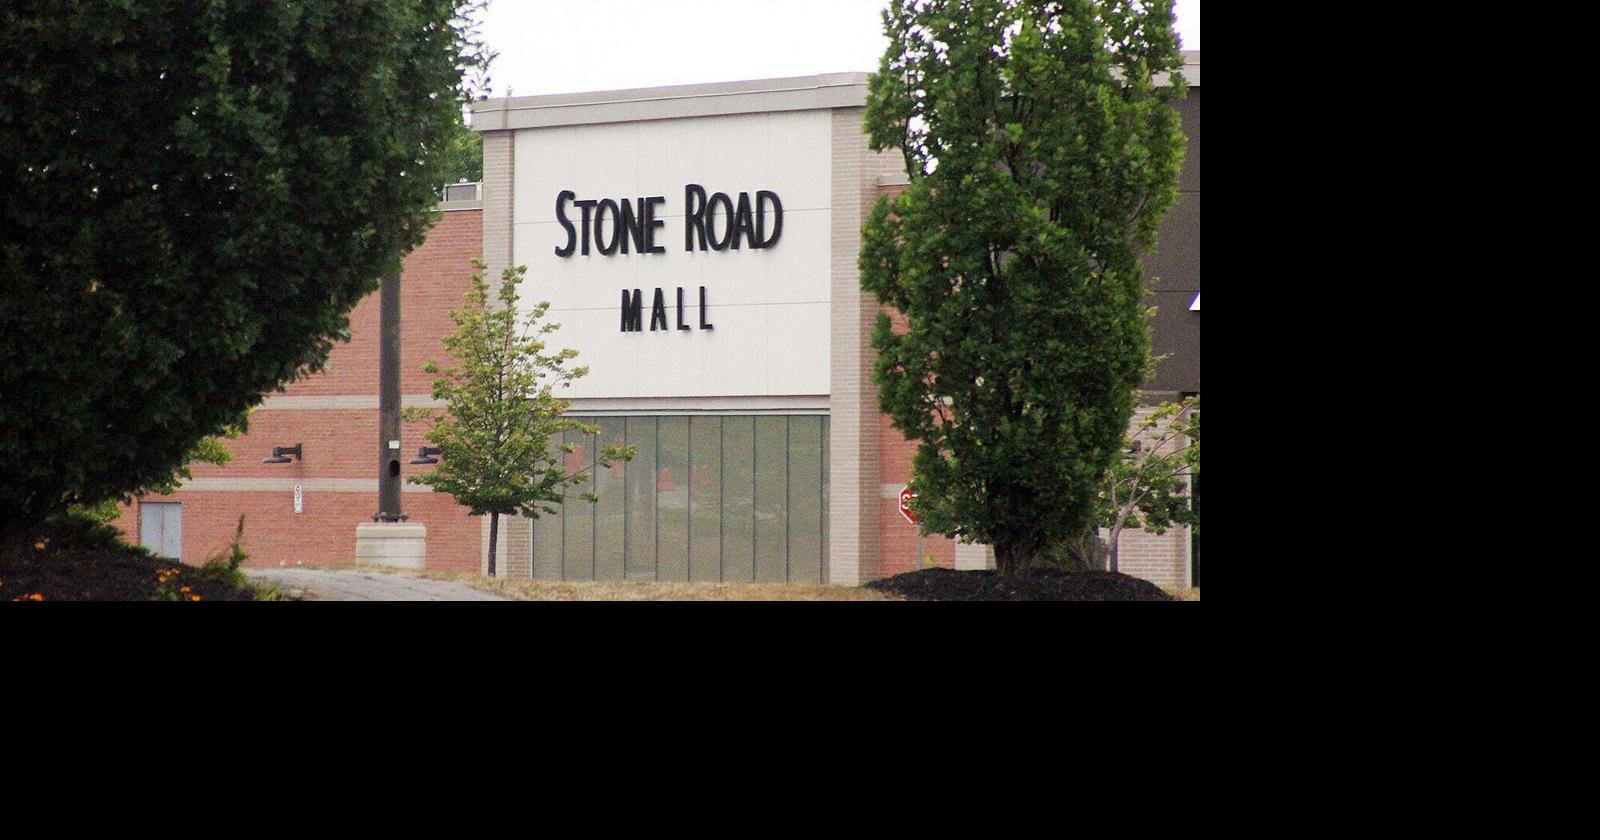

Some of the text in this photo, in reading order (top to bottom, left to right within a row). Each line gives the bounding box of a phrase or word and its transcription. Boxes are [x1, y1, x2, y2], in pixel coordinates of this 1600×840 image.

[555, 184, 784, 258] STONE ROAD
[620, 286, 714, 333] MALL
